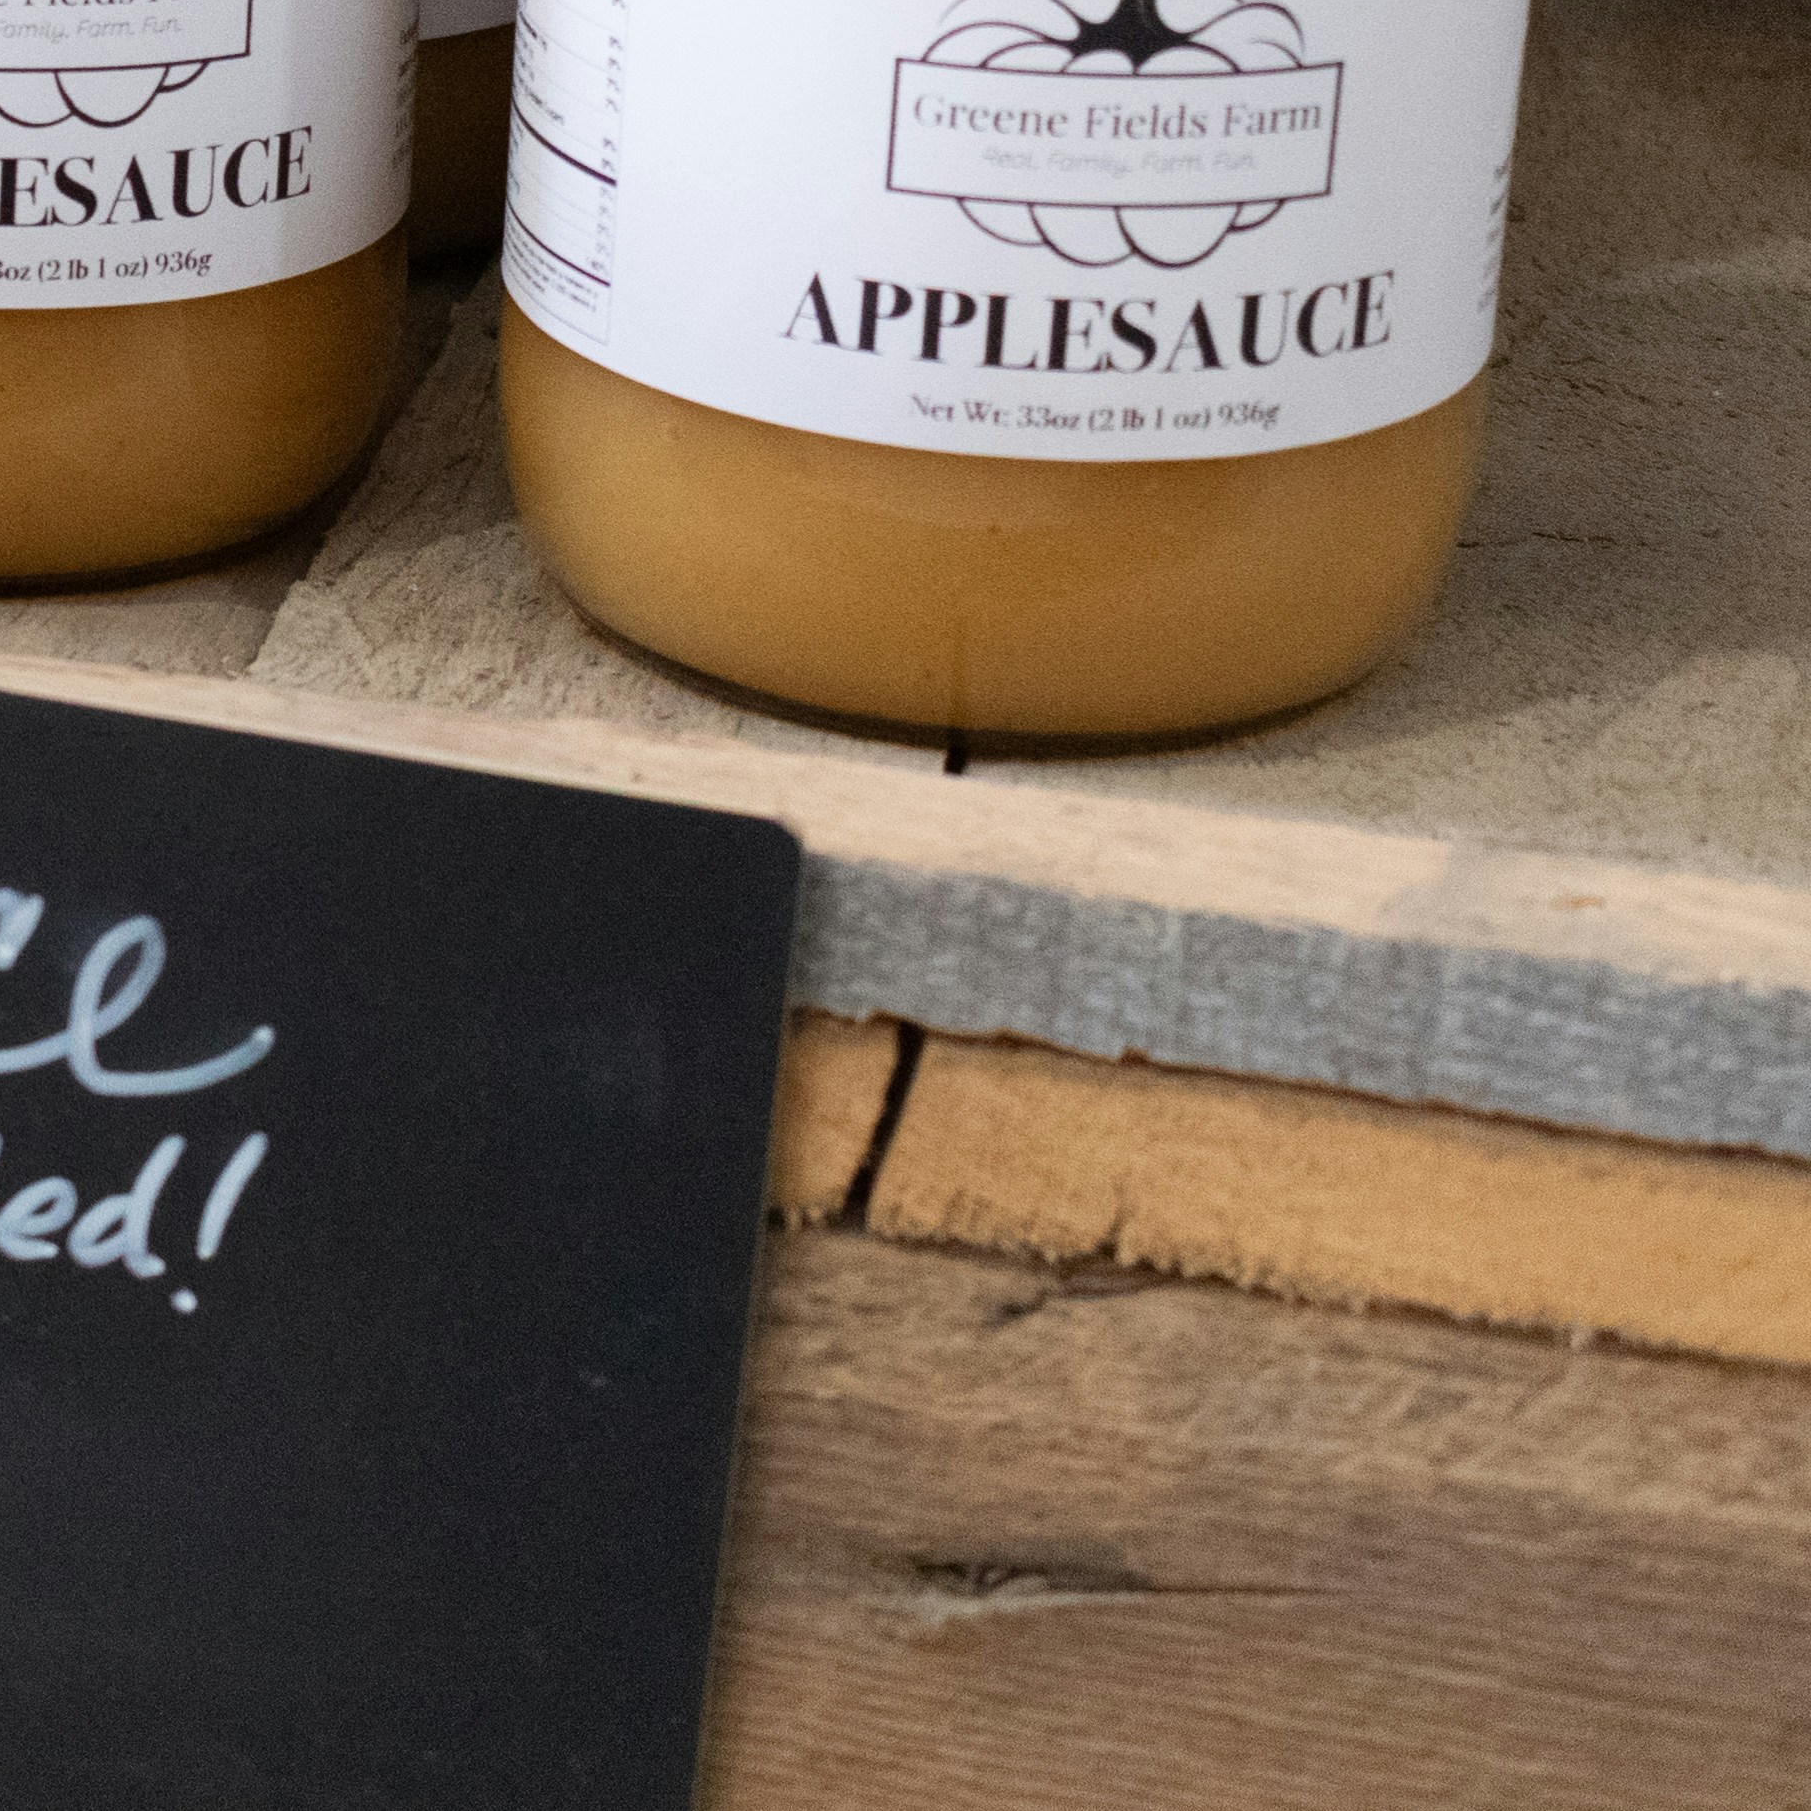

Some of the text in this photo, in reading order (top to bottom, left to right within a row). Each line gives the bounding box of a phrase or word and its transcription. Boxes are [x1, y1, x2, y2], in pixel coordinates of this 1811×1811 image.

[913, 92, 1324, 141] Greene Fields Farm
[37, 257, 64, 284] (2
[65, 256, 89, 281] lb
[113, 253, 151, 281] oz)
[153, 248, 216, 279] 936g
[779, 268, 1396, 374] APPLESAUCE
[1015, 403, 1081, 432] 33oz
[1087, 405, 1116, 433] (2
[1120, 404, 1147, 432] lb
[1216, 398, 1282, 432] 936g
